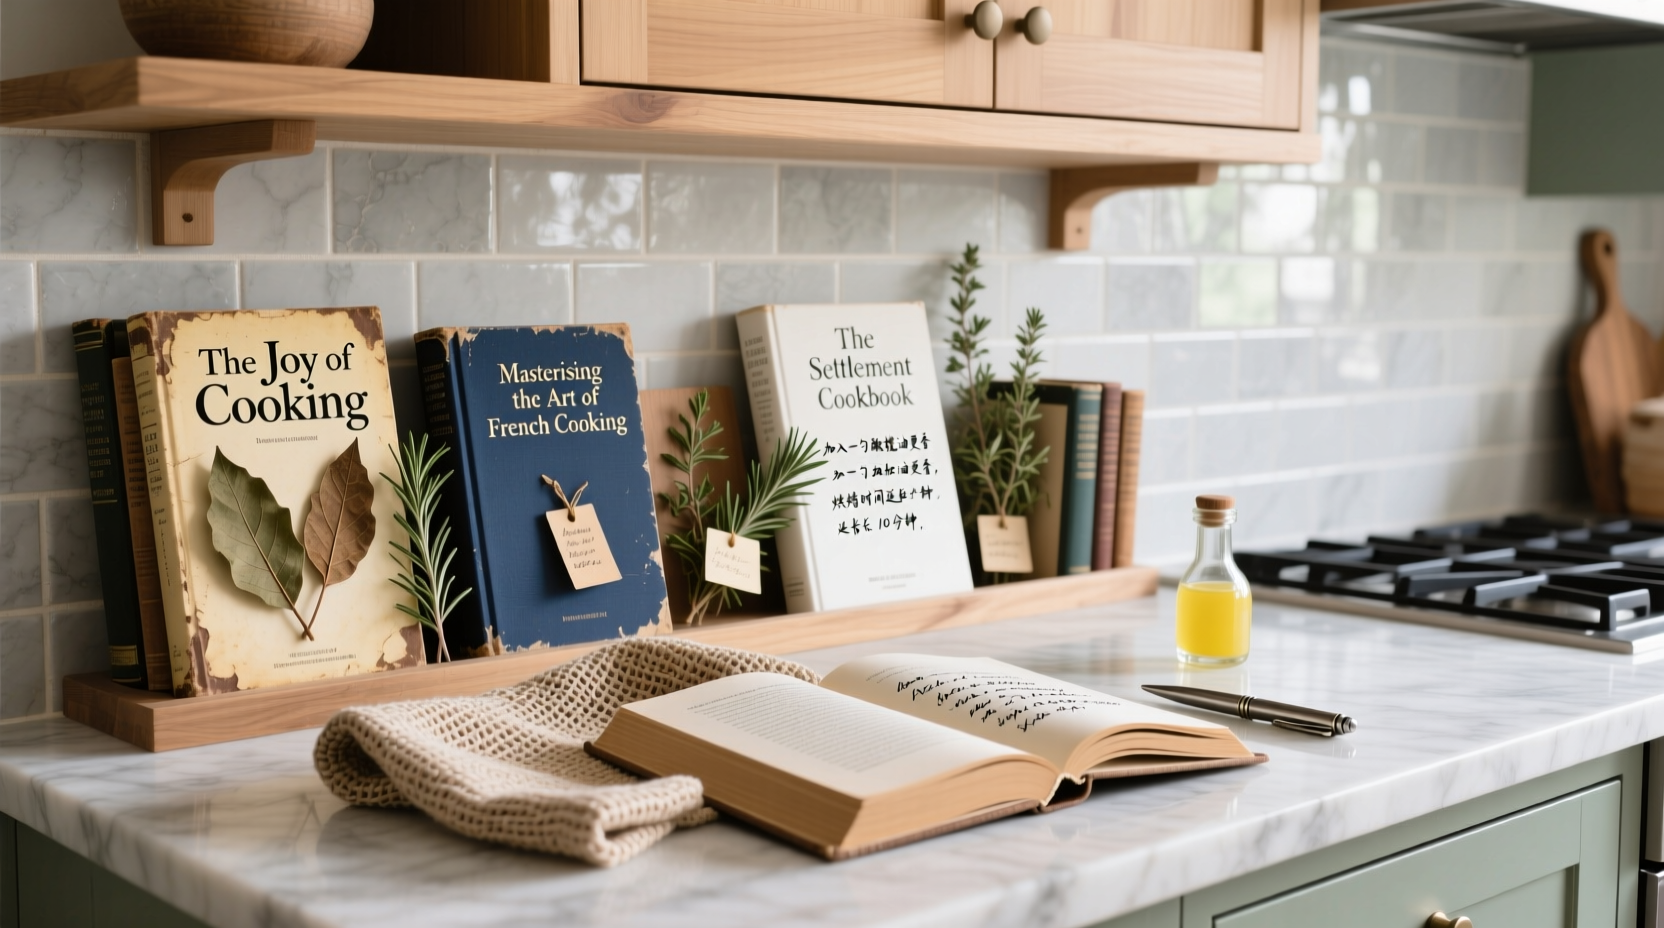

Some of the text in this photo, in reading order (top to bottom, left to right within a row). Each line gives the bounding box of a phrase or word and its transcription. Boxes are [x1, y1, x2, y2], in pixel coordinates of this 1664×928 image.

[834, 326, 874, 350] The
[198, 340, 355, 386] The Joy of
[497, 361, 603, 385] Masterising
[809, 355, 912, 381] Settlement
[195, 382, 369, 431] Cooking
[512, 386, 600, 410] the Art of
[818, 383, 914, 410] Cookbook
[487, 412, 628, 439] French Cooking
